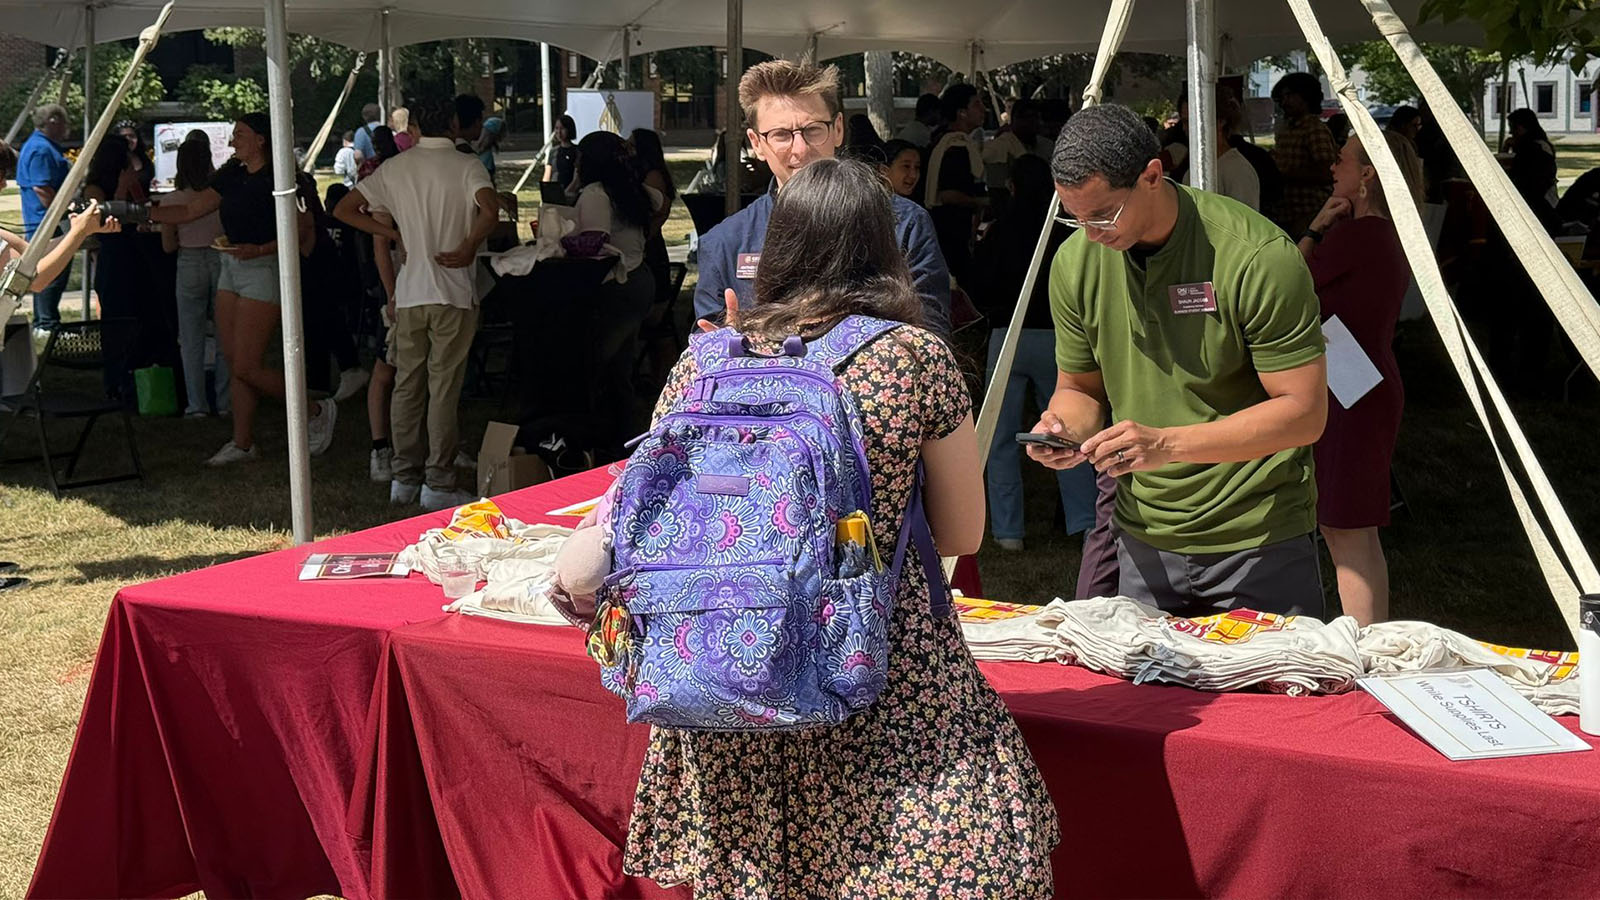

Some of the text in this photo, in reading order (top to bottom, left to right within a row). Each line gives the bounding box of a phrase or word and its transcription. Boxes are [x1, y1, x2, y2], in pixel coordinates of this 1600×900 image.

[1416, 680, 1503, 746] While Supplies Last
[1454, 695, 1506, 730] TSHIRTS
